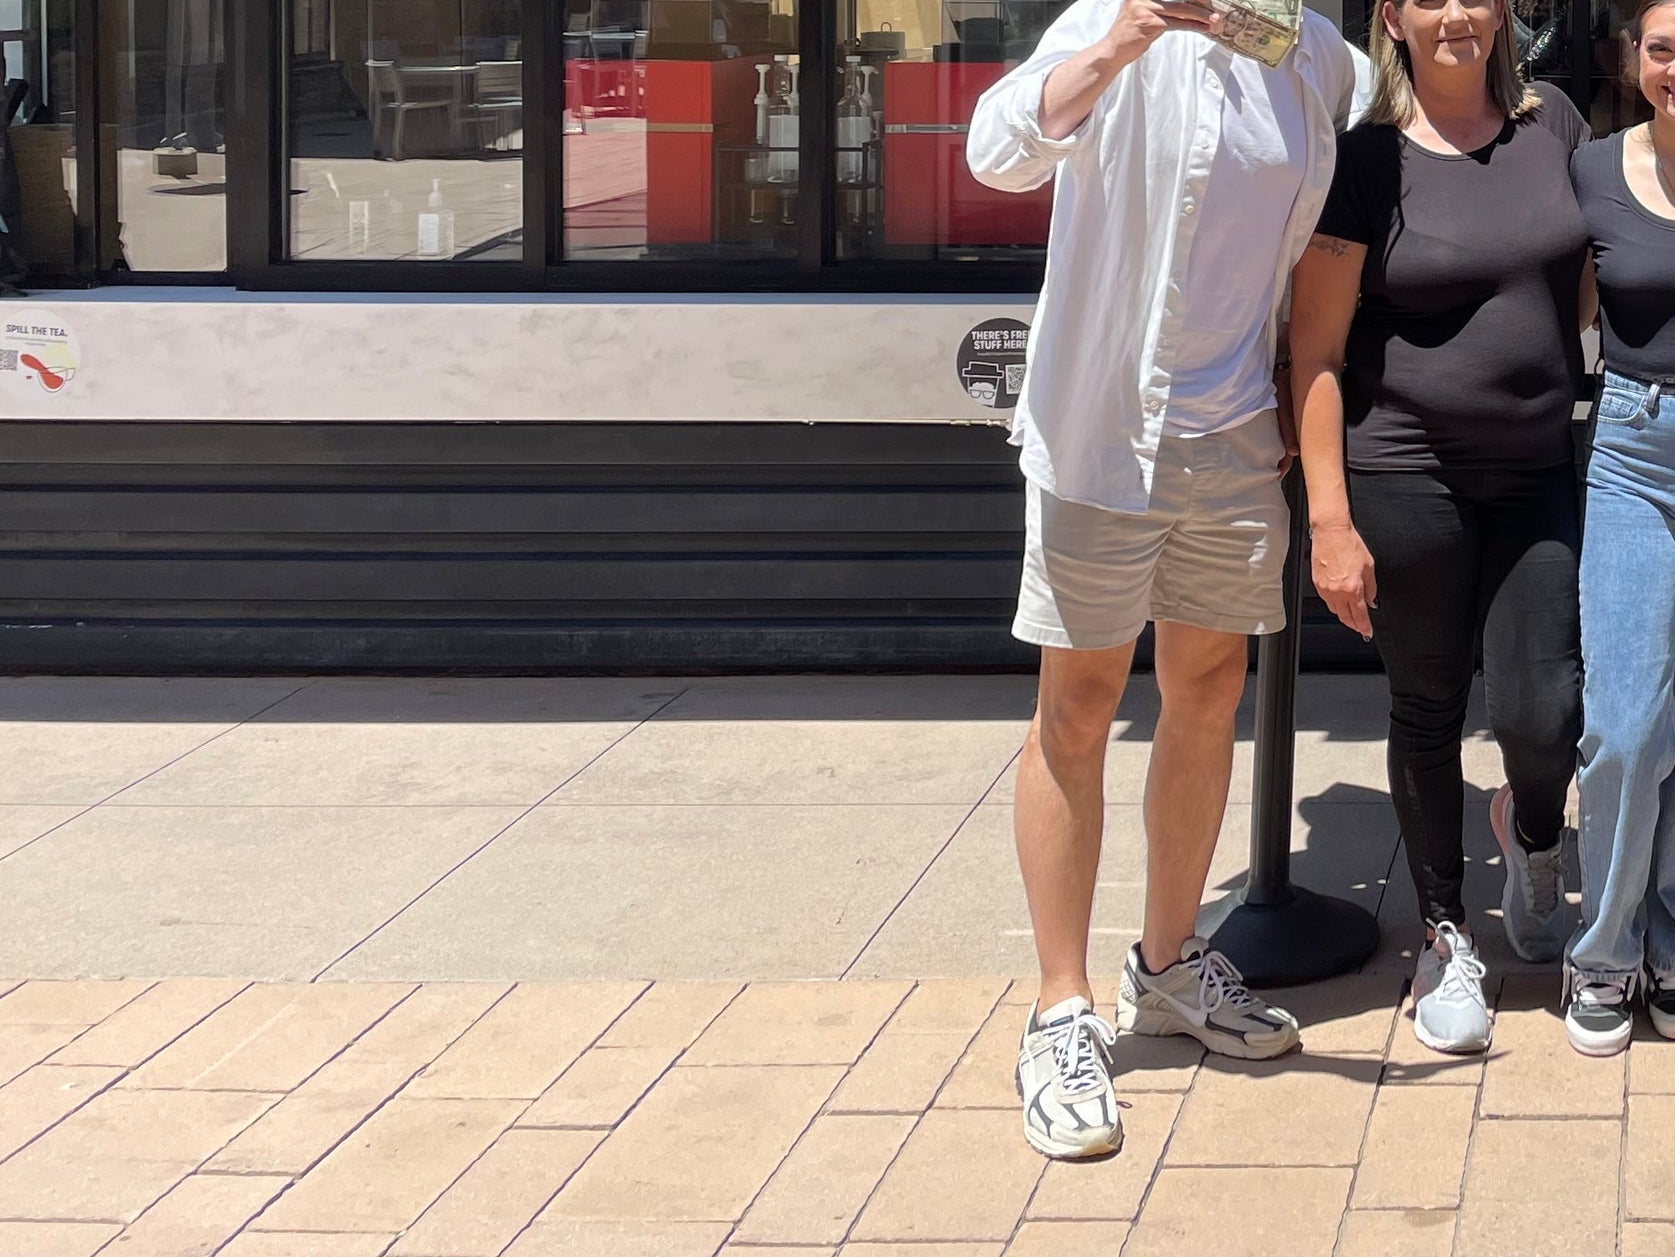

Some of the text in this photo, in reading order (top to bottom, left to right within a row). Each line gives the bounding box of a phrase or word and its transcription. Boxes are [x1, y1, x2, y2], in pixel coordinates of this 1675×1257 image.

[6, 324, 68, 336] SPILL THE TEA.
[971, 330, 1030, 340] THERE'S FRE
[973, 340, 1002, 350] STUFF
